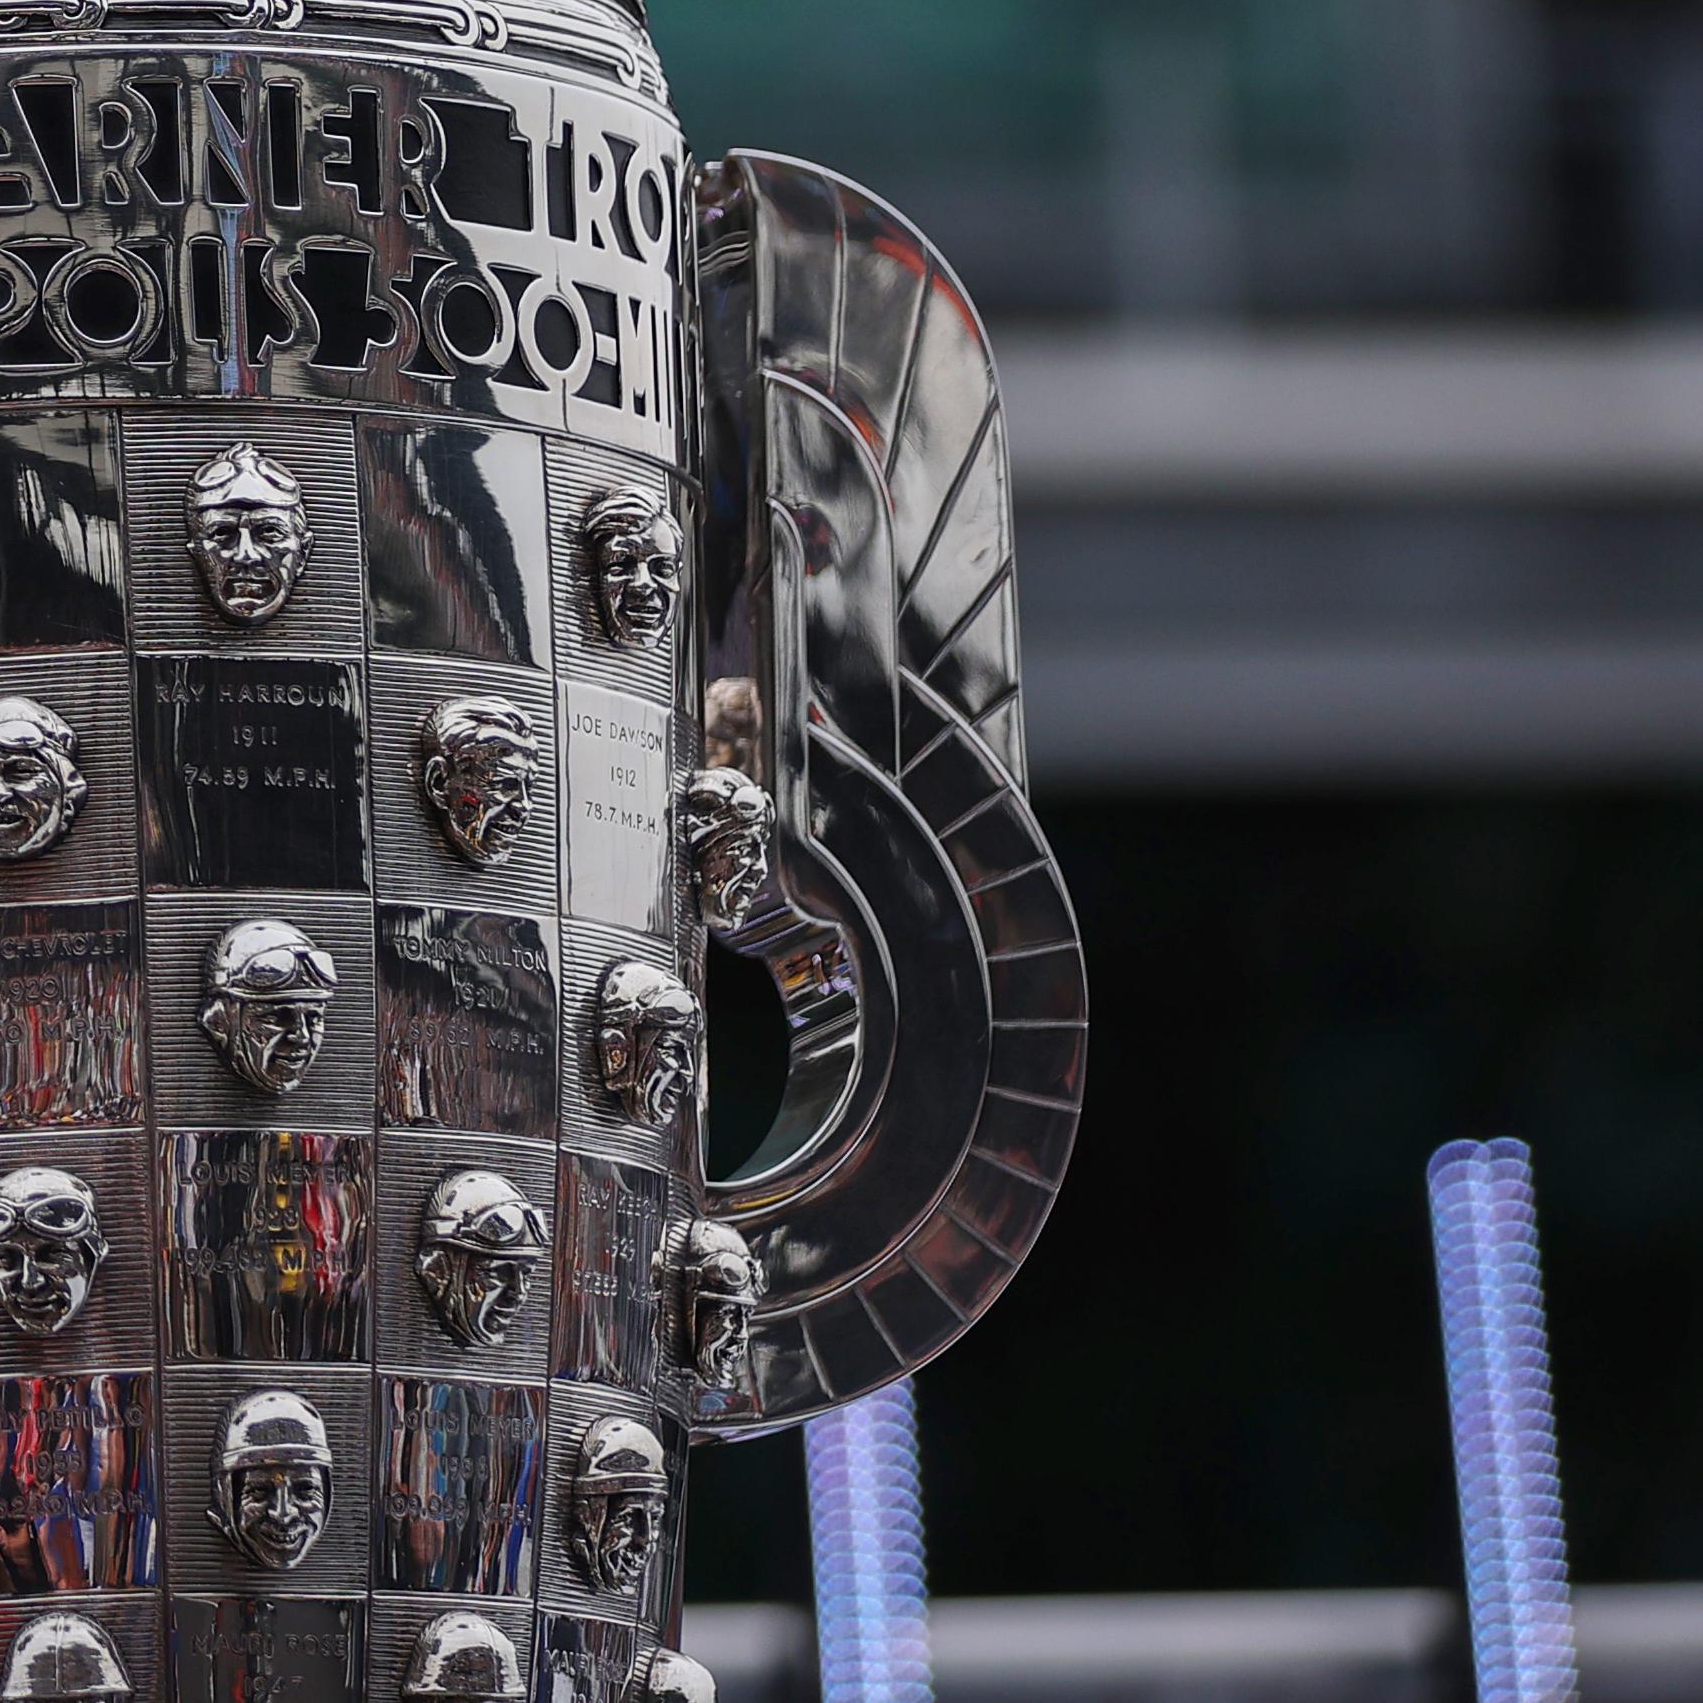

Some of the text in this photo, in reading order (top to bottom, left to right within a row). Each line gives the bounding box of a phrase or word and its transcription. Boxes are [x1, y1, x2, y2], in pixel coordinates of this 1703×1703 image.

[155, 680, 347, 709] RAY HARROUN
[231, 724, 279, 747] 1911
[571, 713, 663, 753] JOE DAWSON
[262, 765, 338, 791] M.P.H.
[610, 765, 637, 788] 1912
[394, 935, 548, 972] TOMMY MILTON
[178, 1160, 256, 1187] LOUIS
[284, 1632, 349, 1659] ROSE
